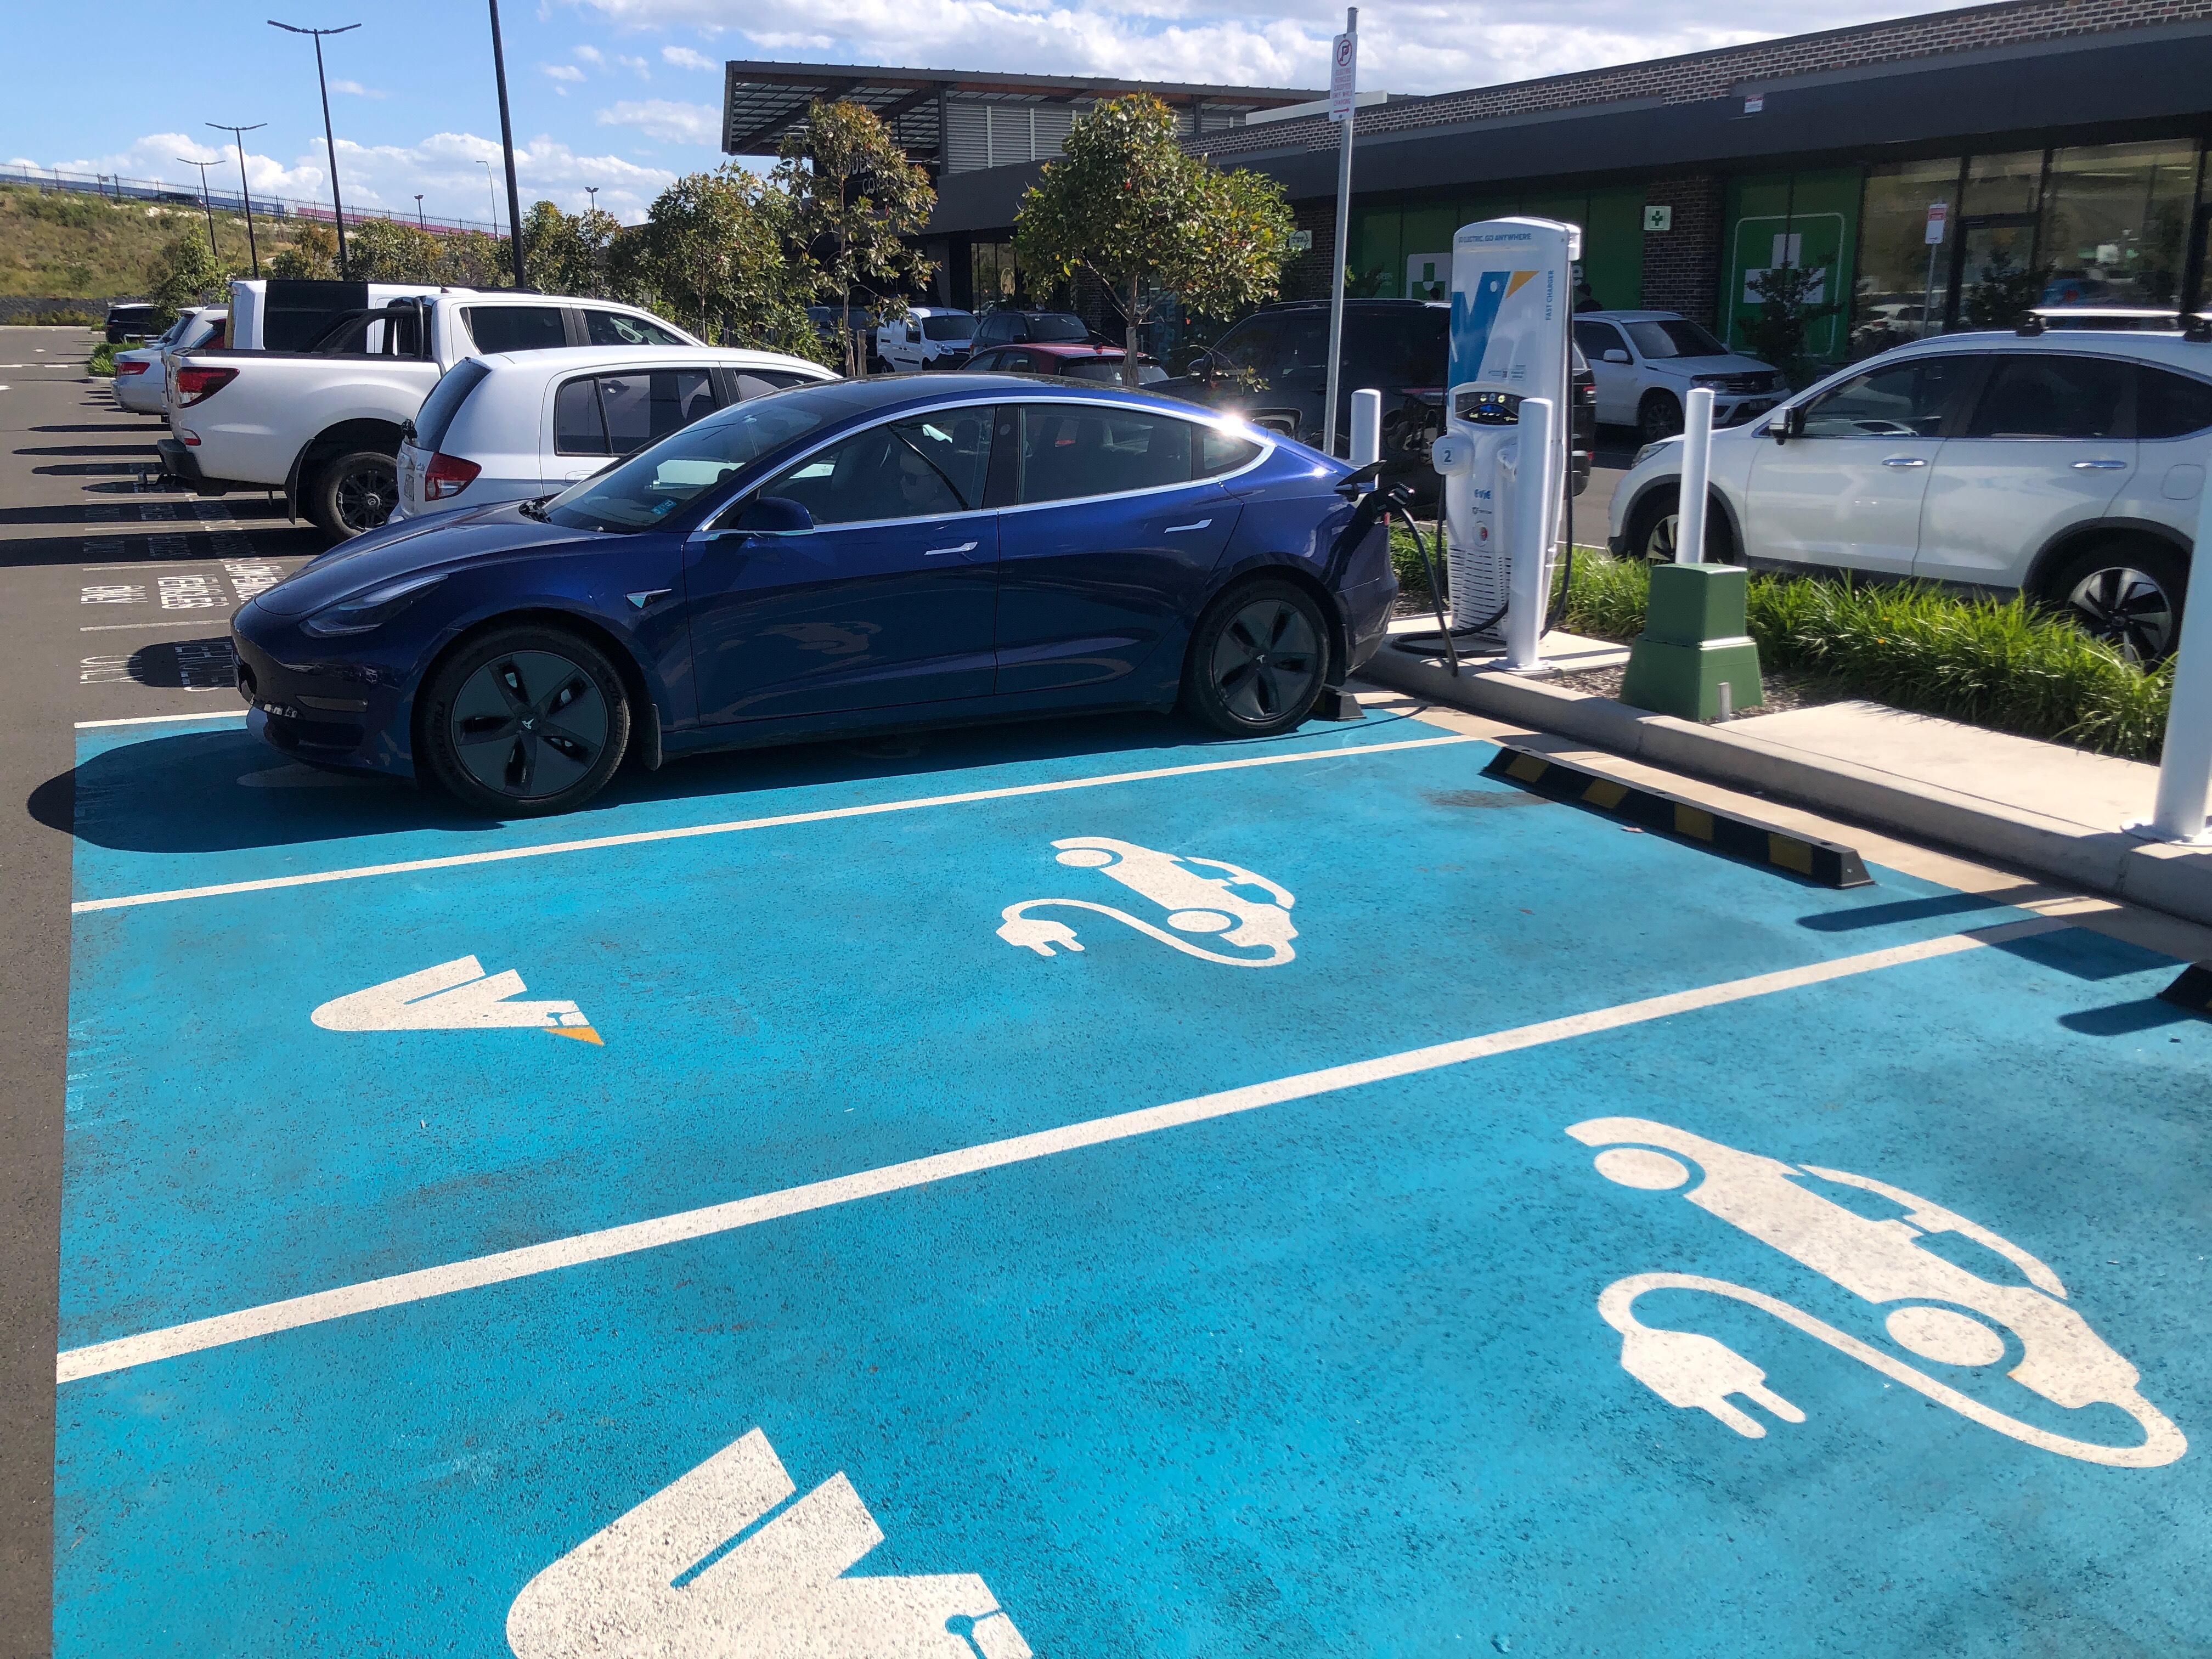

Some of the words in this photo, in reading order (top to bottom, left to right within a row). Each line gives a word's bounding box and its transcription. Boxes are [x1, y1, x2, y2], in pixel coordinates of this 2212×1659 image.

[1443, 450, 1452, 462] 2
[81, 585, 148, 603] ONLY
[157, 574, 230, 609] VEHICLES
[80, 654, 144, 684] ONLY
